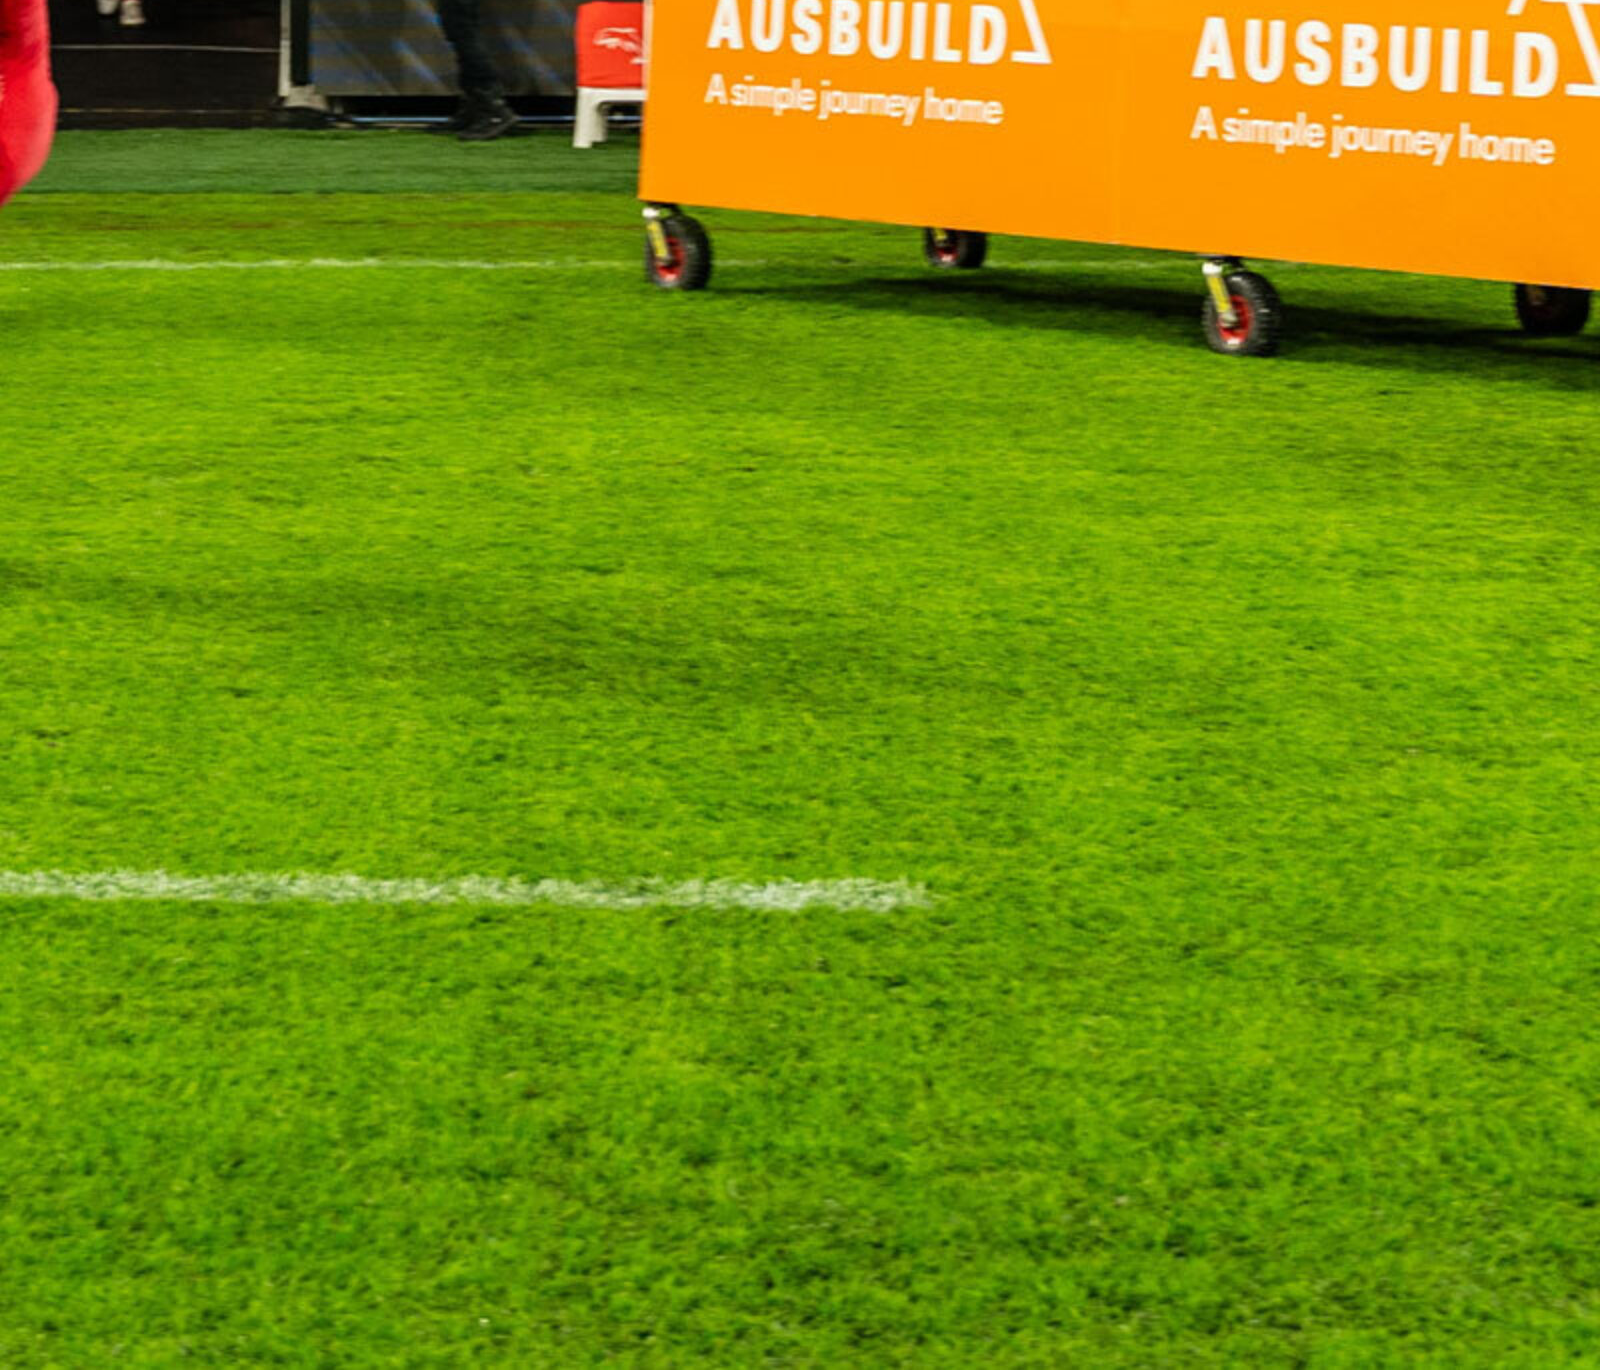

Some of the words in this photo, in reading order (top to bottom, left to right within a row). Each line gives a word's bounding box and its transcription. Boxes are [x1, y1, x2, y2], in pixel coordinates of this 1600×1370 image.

[1191, 16, 1559, 98] AUSBUILD
[704, 73, 728, 105] A
[730, 75, 816, 116] simple
[817, 80, 921, 127] journey
[923, 86, 1004, 124] home
[1190, 106, 1218, 140] A
[1222, 107, 1326, 153] simple
[1328, 114, 1453, 166] journey
[1459, 122, 1556, 165] home
